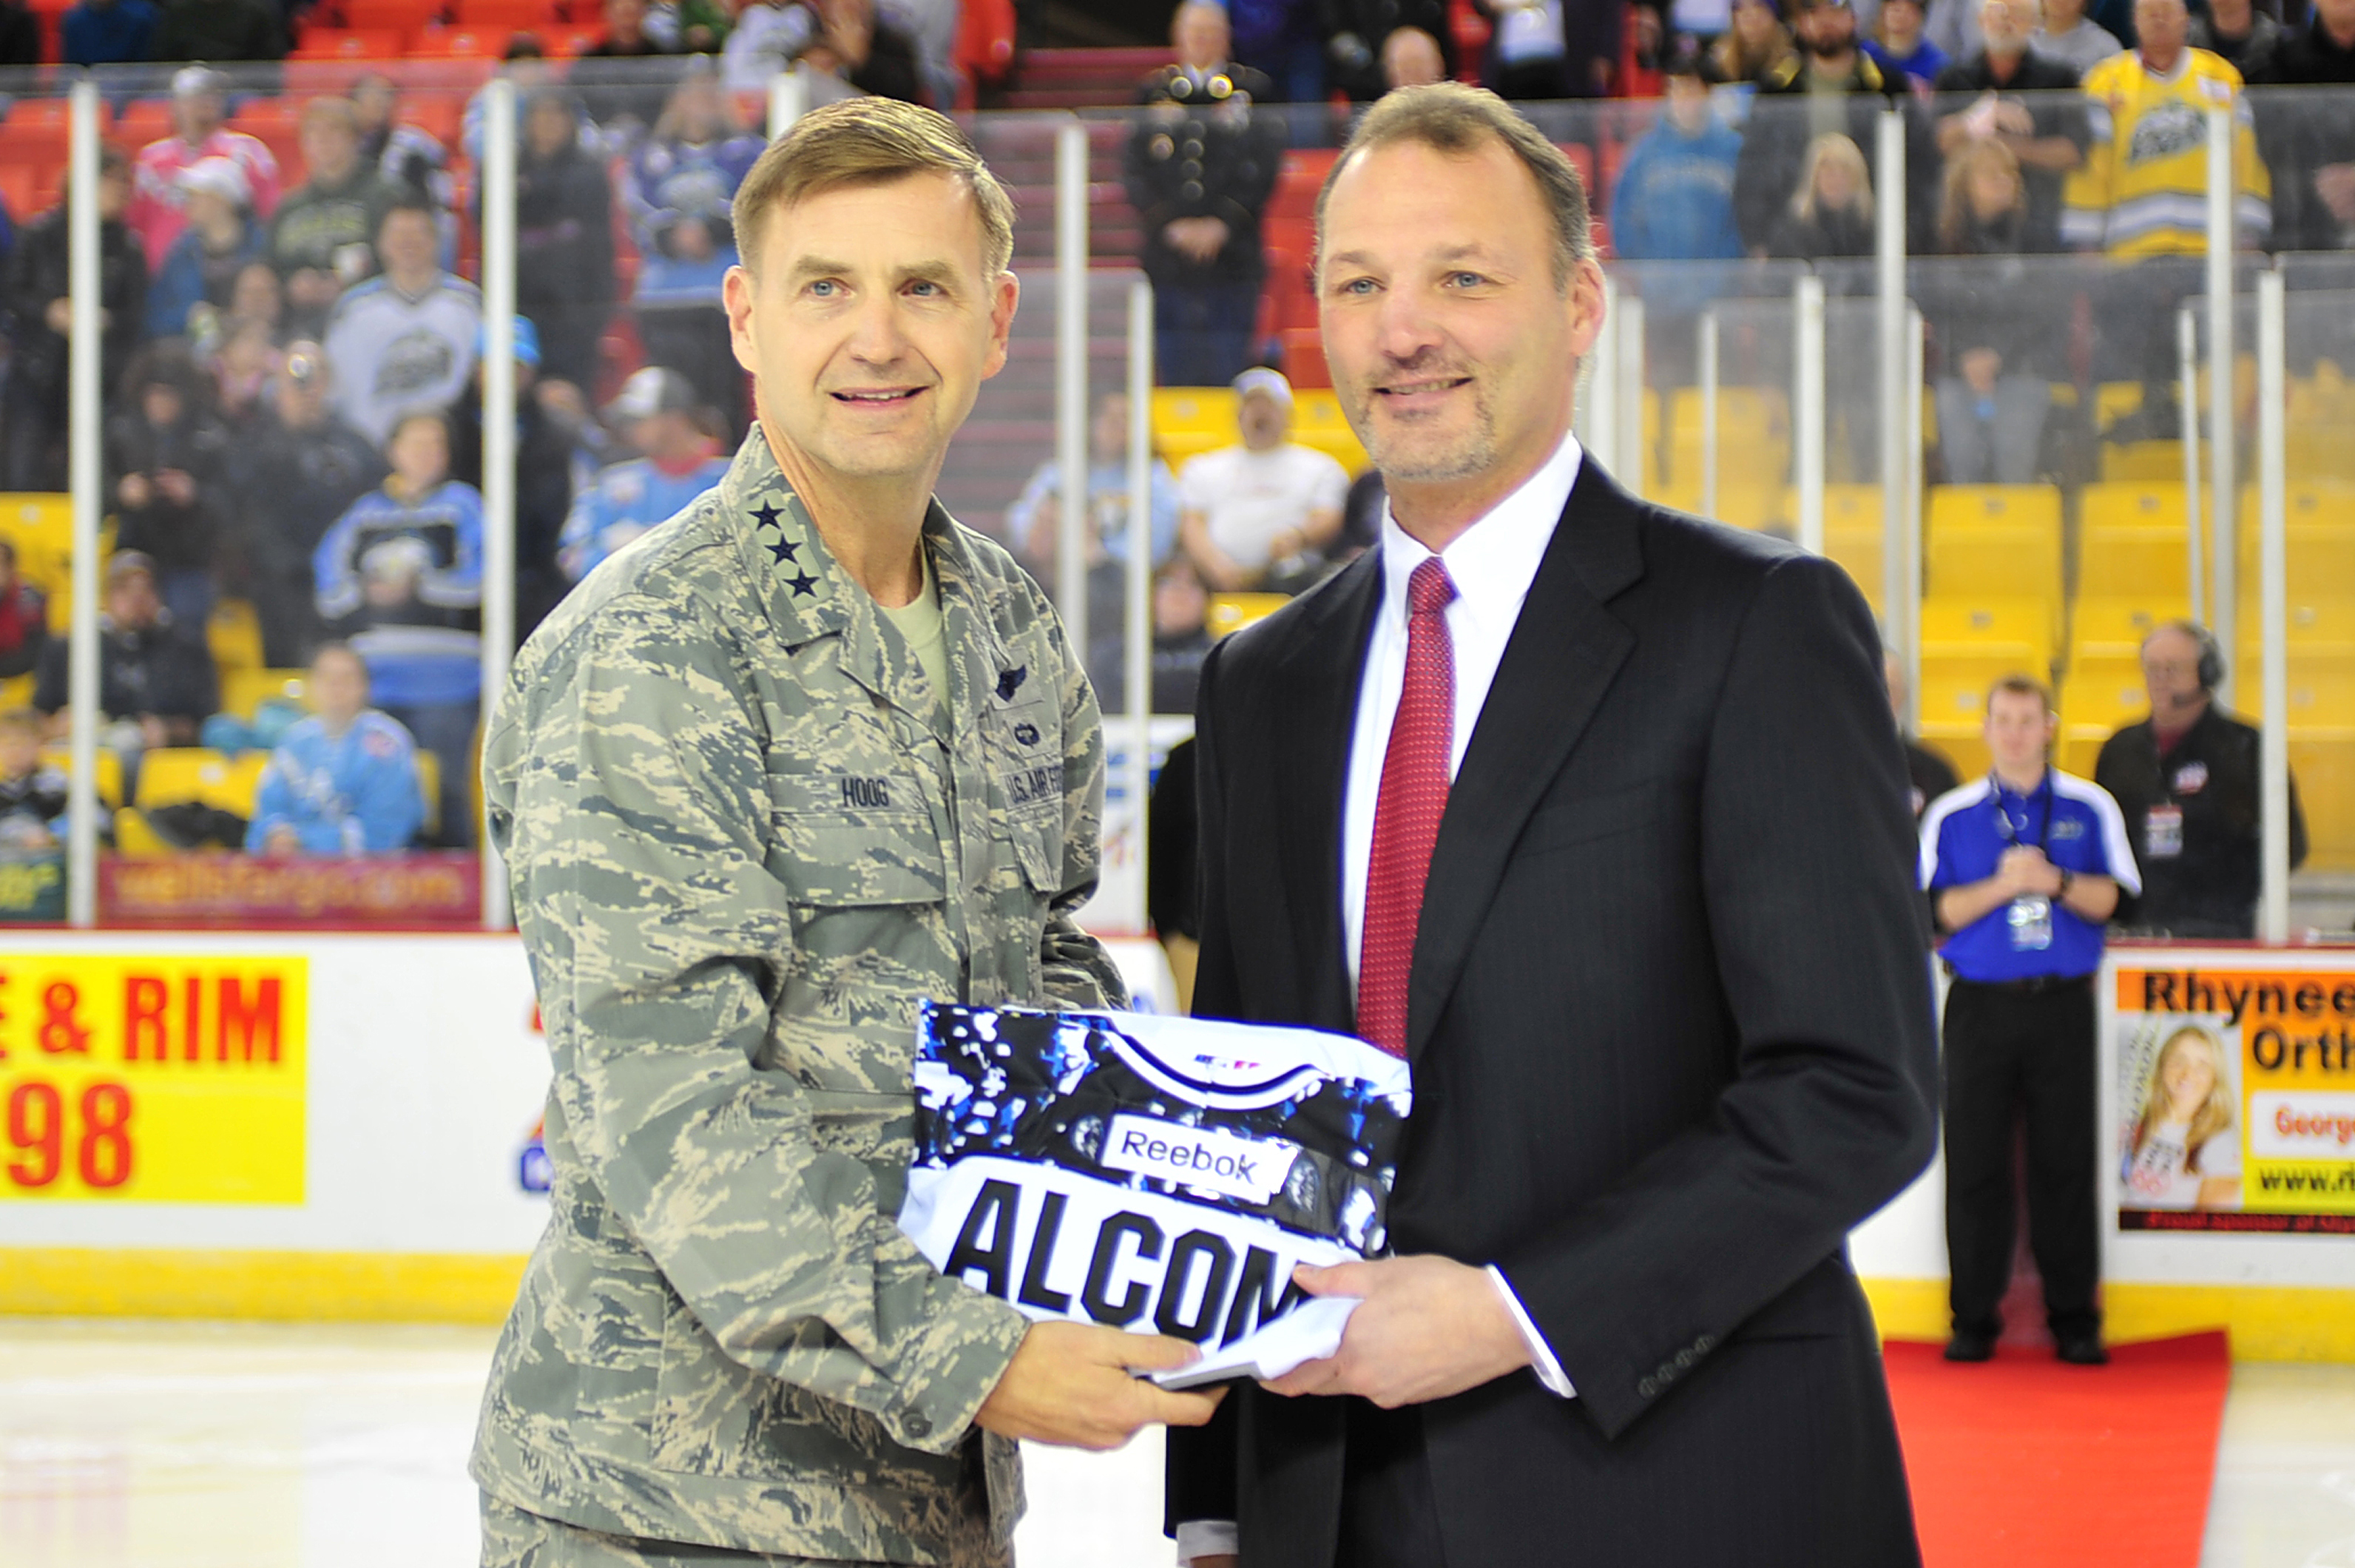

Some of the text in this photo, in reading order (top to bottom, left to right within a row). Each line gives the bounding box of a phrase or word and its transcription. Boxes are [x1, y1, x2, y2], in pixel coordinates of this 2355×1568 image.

[842, 777, 889, 808] HOOG
[1025, 767, 1050, 800] AIR
[38, 982, 90, 1053] &
[124, 976, 283, 1061] RIM
[7, 1082, 133, 1187] 98
[2274, 1106, 2355, 1144] Georg
[1121, 1130, 1258, 1185] Reebok
[942, 1177, 1312, 1352] ALCOM
